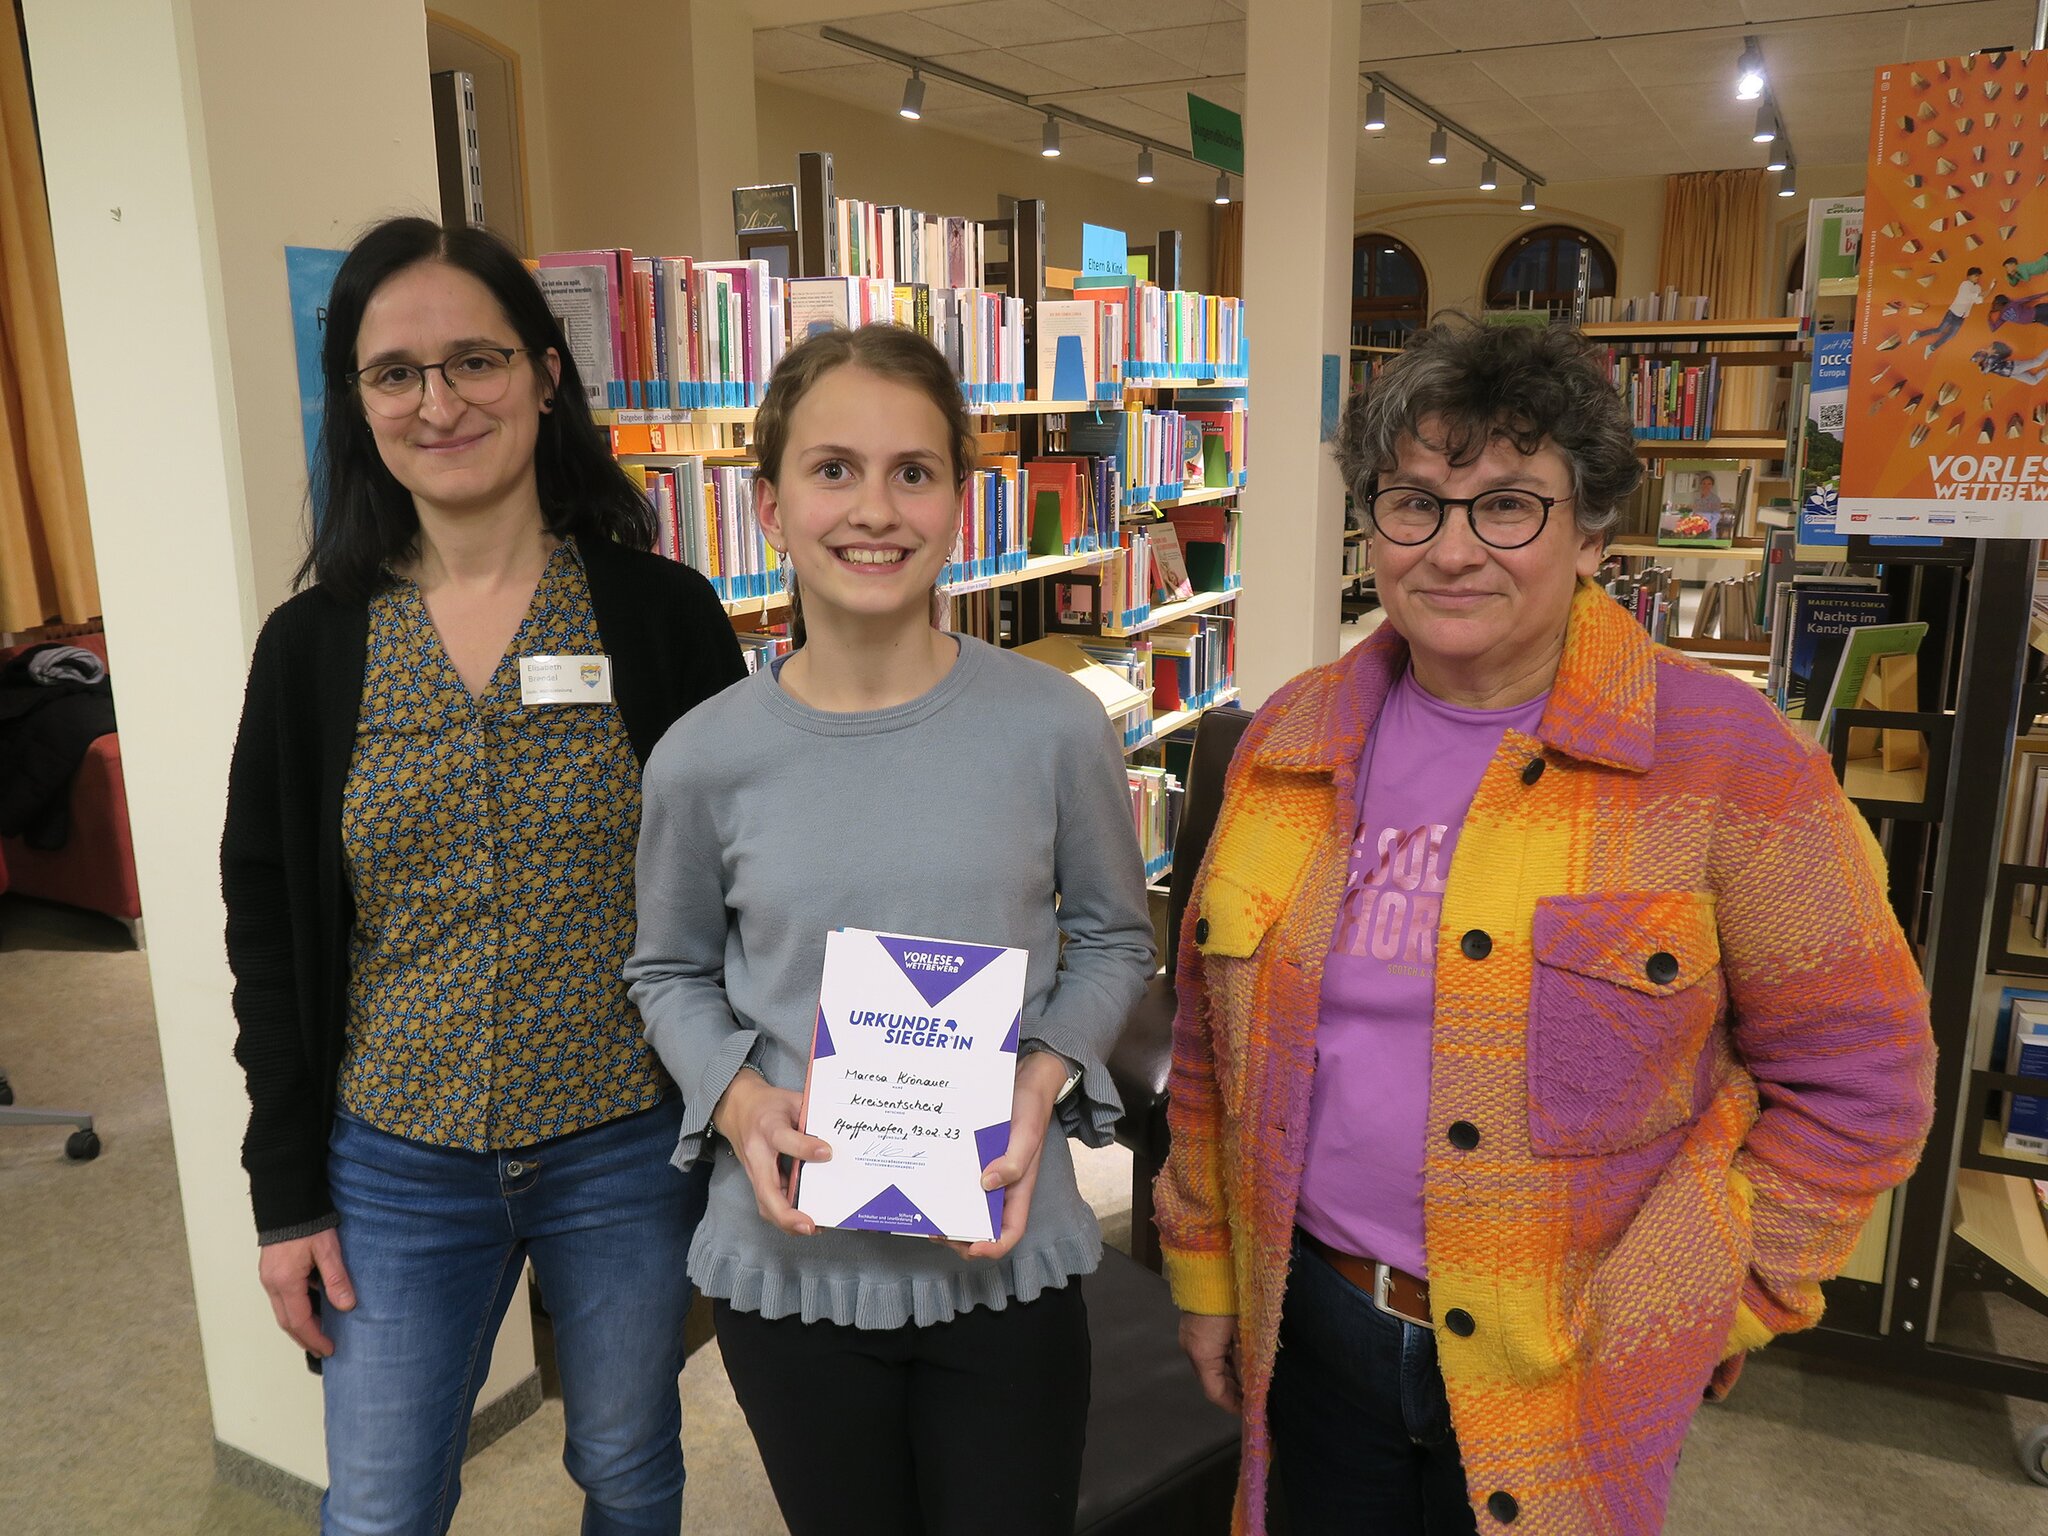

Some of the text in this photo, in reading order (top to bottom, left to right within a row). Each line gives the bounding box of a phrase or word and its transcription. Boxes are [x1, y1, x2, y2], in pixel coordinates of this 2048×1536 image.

[1088, 258, 1123, 275] Eltern & Kind
[1819, 368, 1846, 378] Europa
[620, 414, 643, 423] Ratgeber
[1807, 599, 1886, 609] MARIETTA SLOMKA
[1813, 611, 1877, 624] Nachts im
[903, 951, 953, 966] VORLESE
[905, 961, 959, 974] WETTBEWERB
[1387, 963, 1418, 976] SCOTCH
[849, 1010, 941, 1032] URKUNDE
[850, 1093, 944, 1115] Kreisentscheid
